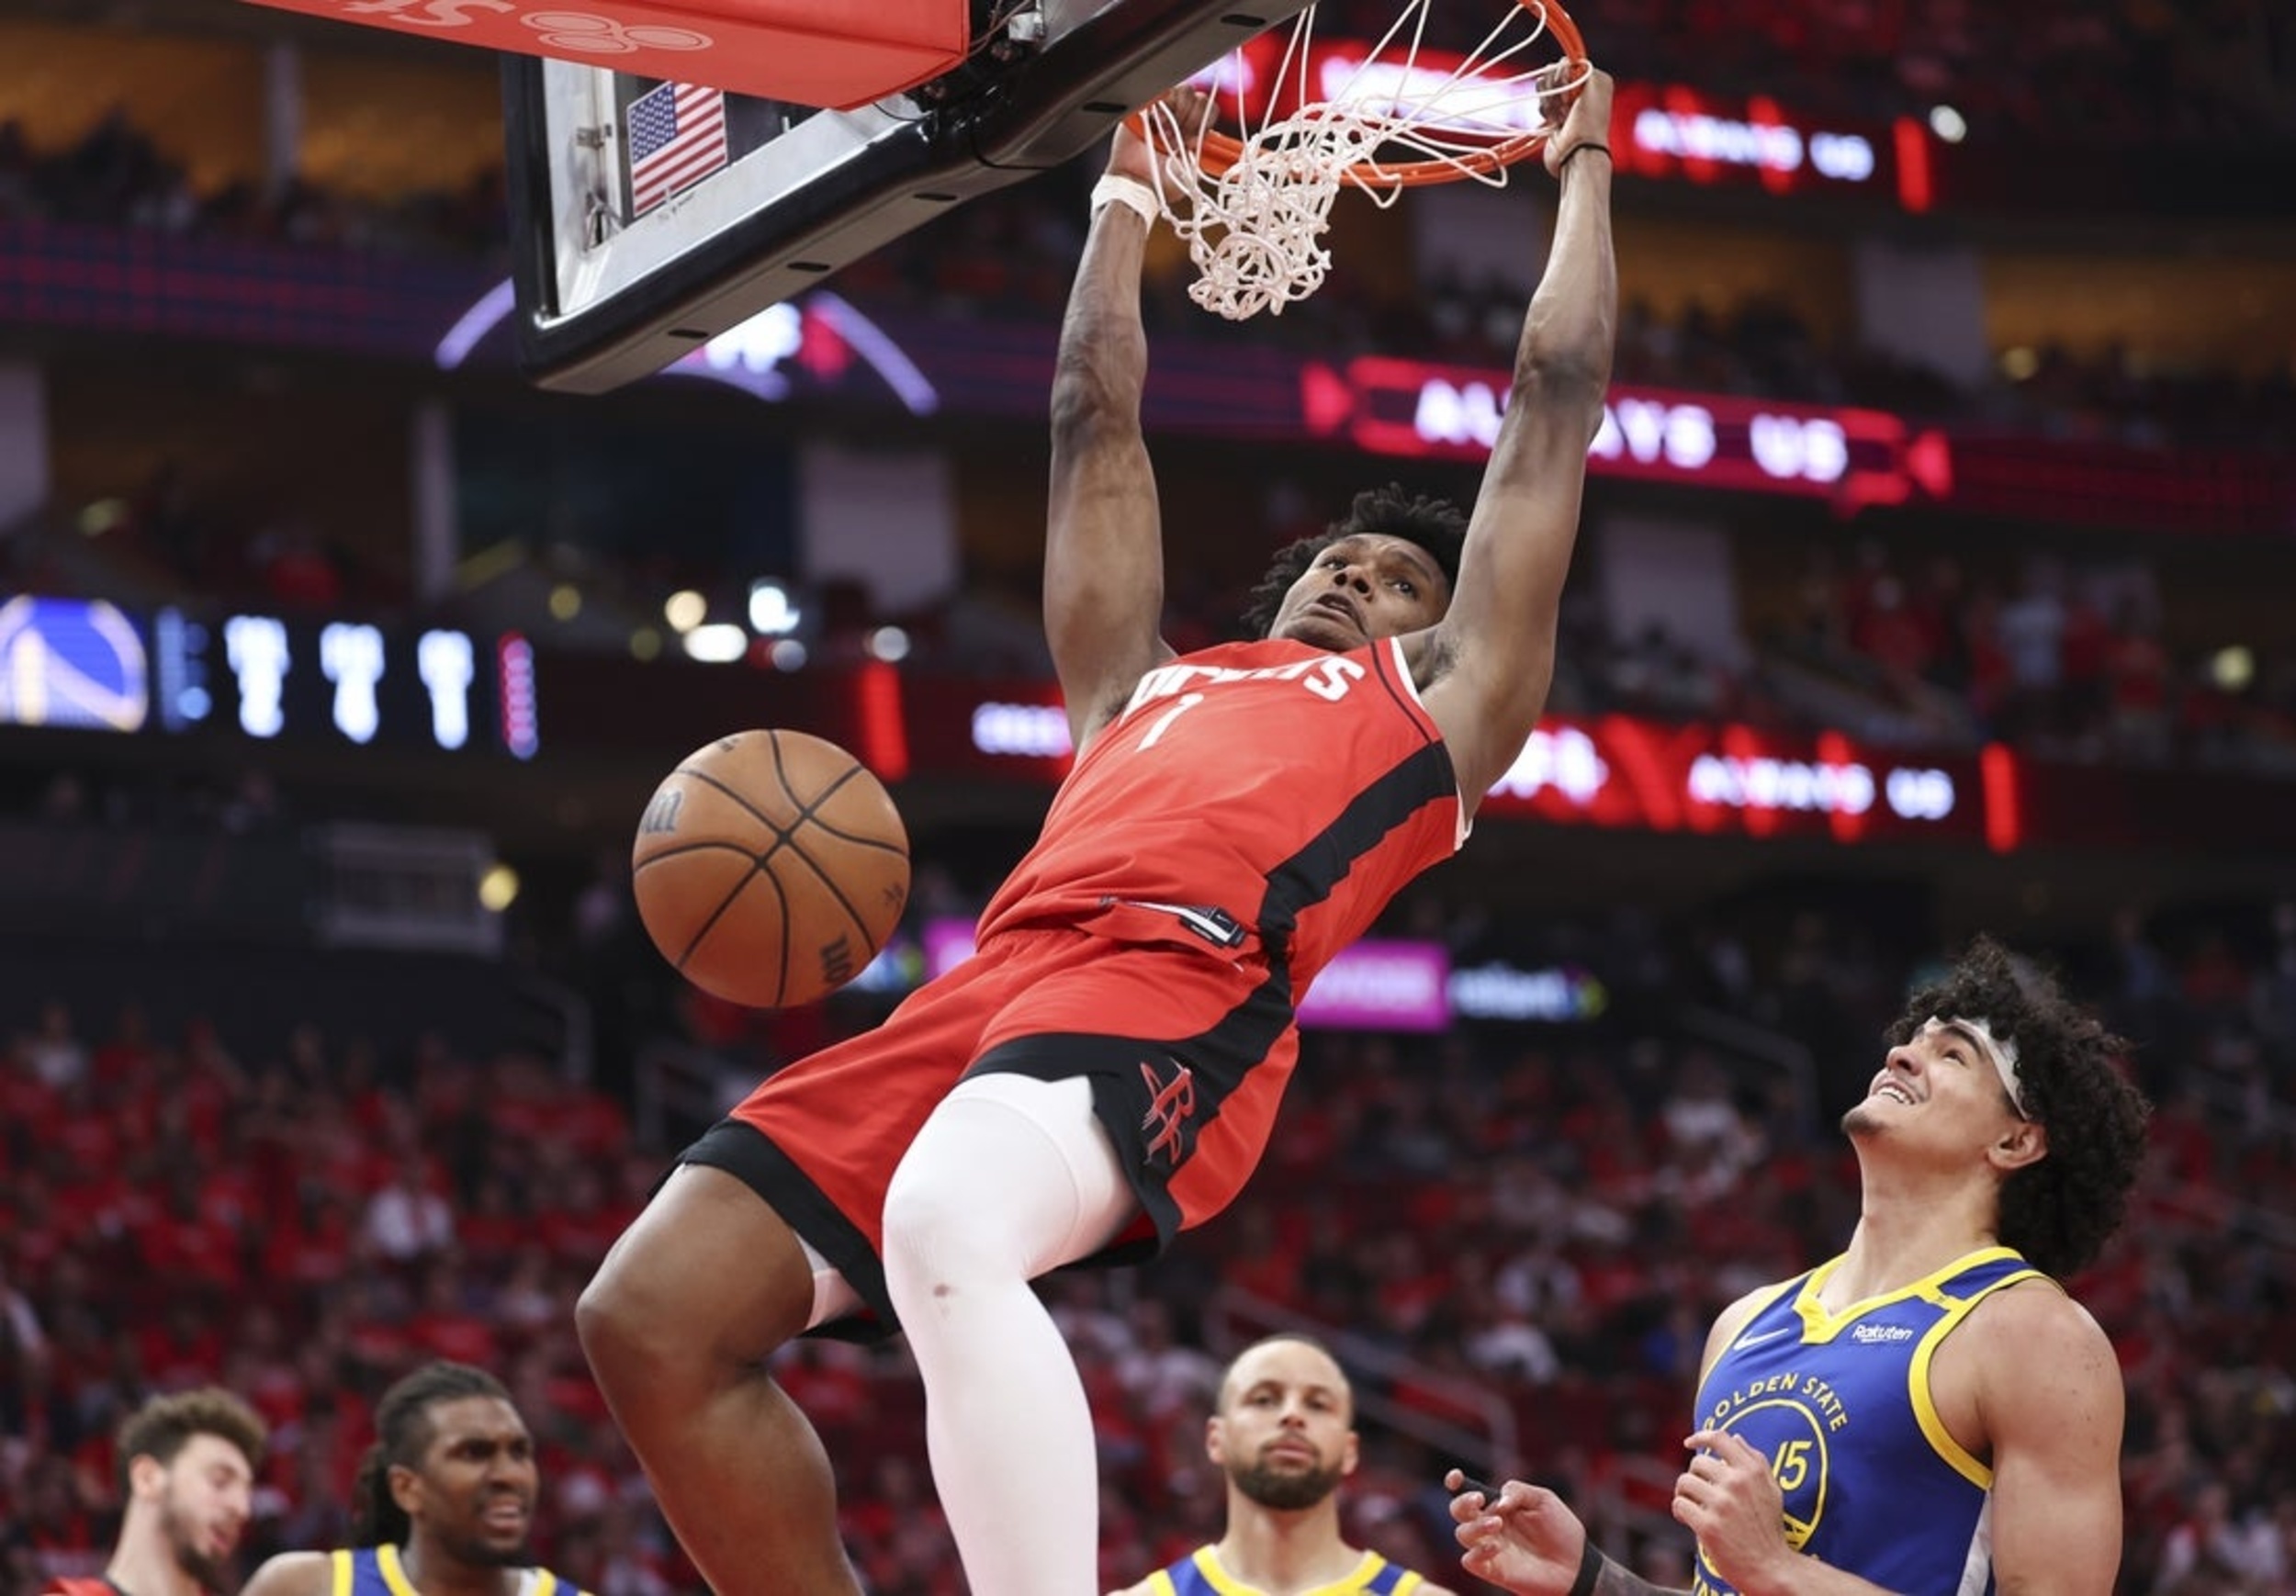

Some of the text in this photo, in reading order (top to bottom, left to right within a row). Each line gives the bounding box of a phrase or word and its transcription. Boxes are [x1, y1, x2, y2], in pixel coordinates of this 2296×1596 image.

[1415, 378, 1716, 468] ALAYS
[1135, 692, 1204, 752] 1
[1852, 1324, 1913, 1343] Rakuten
[1704, 1372, 1848, 1432] GOLDEN STATE
[1773, 1440, 1813, 1490] 15
